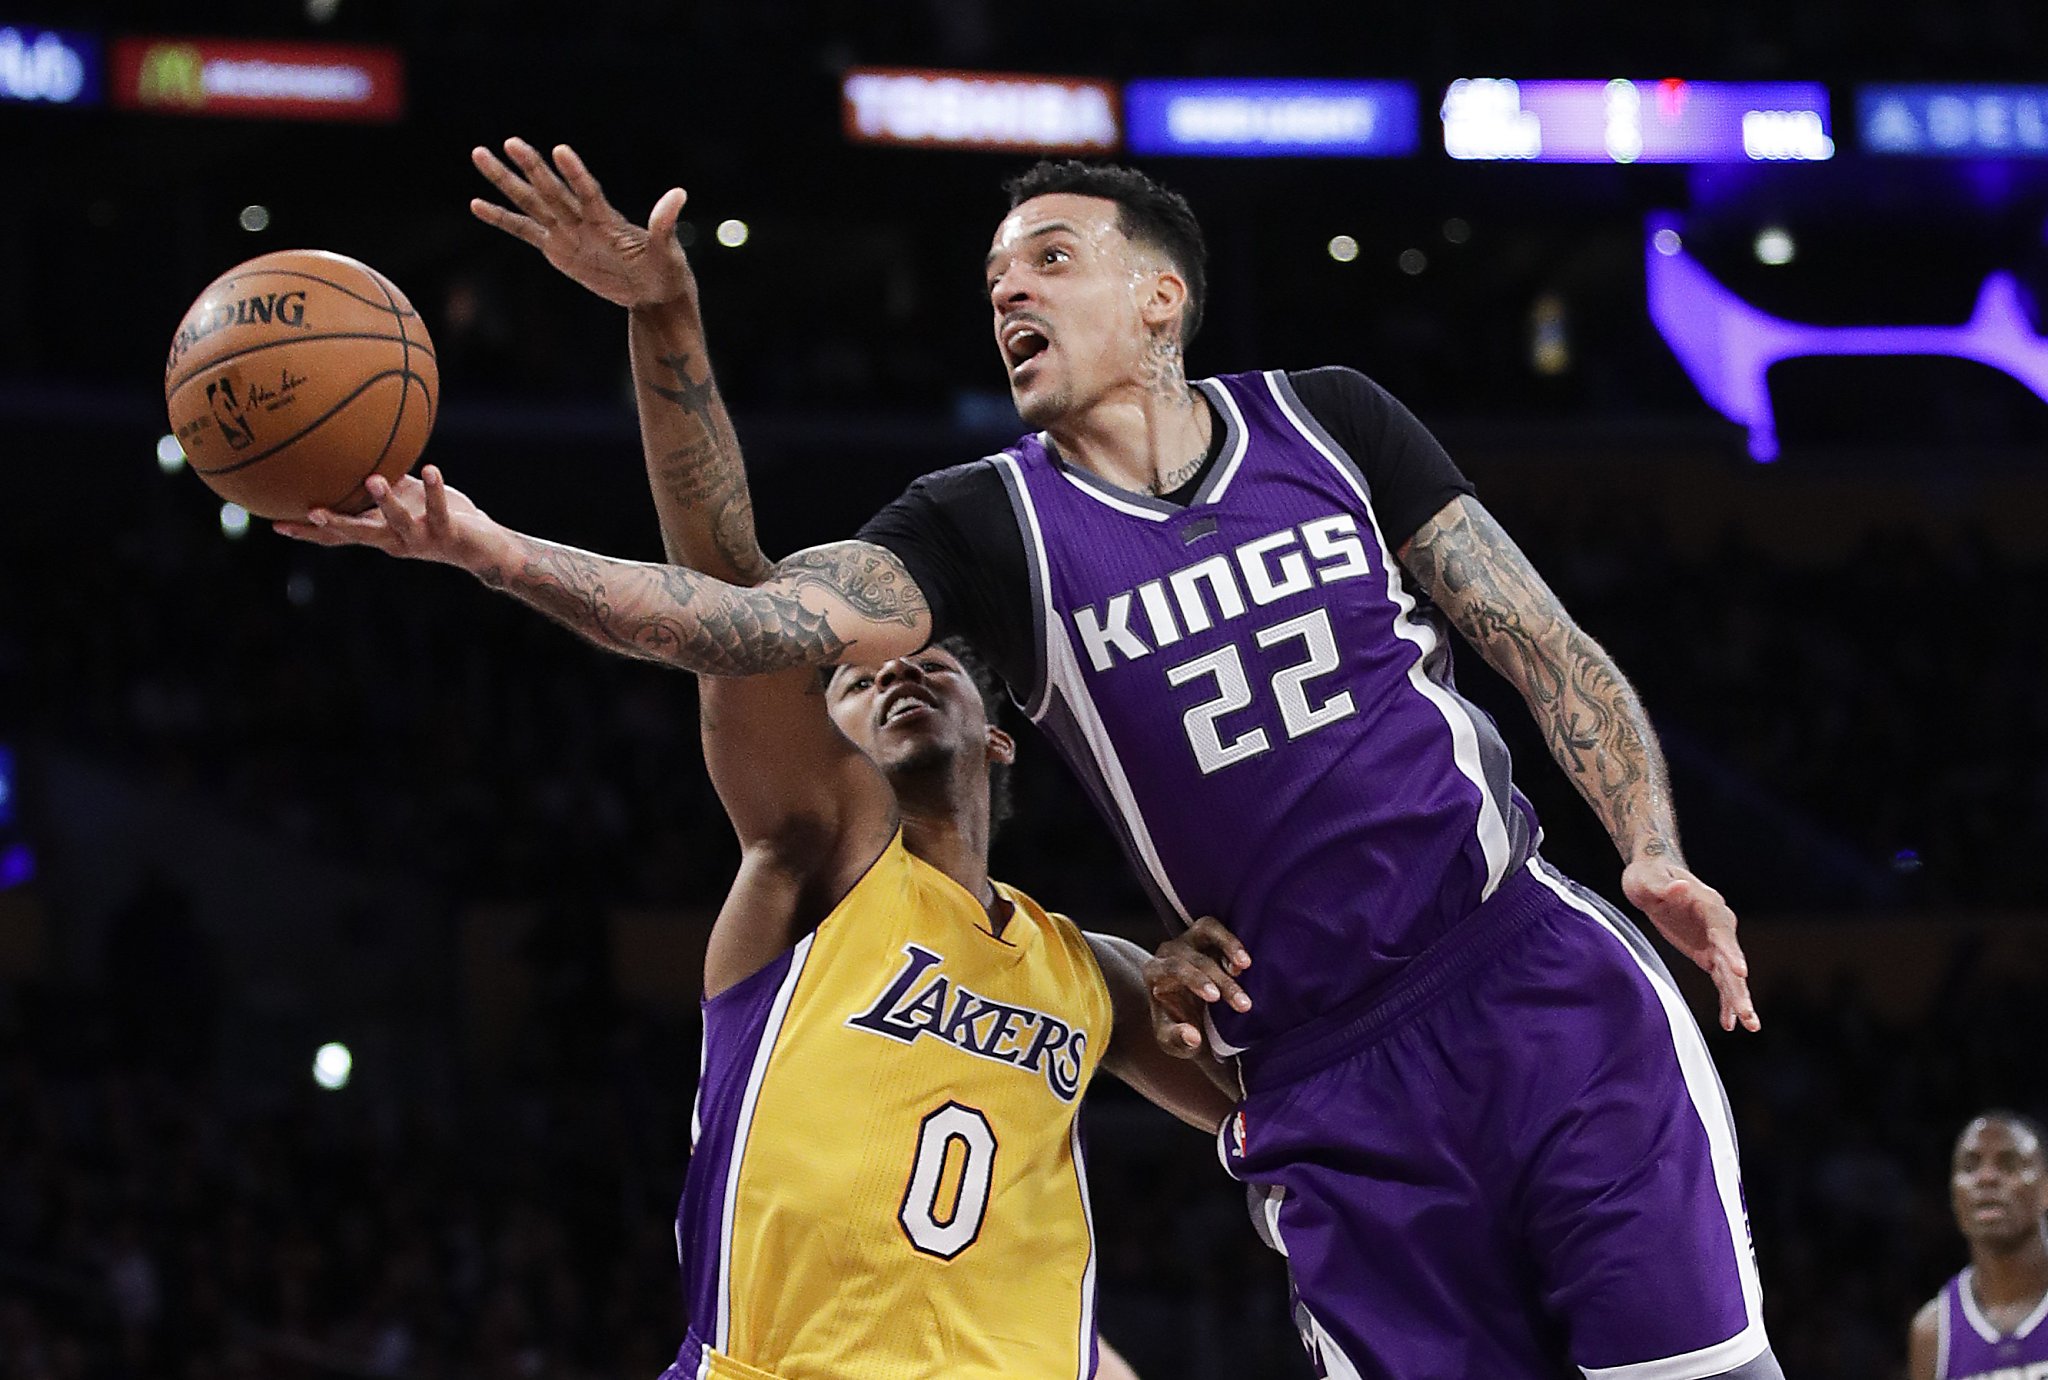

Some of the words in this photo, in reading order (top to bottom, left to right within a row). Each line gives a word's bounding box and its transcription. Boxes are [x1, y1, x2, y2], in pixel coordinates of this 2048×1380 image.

[1072, 513, 1371, 672] KINGS
[1164, 607, 1358, 775] 22
[843, 941, 1087, 1104] LAKERS
[897, 1099, 999, 1262] 0
